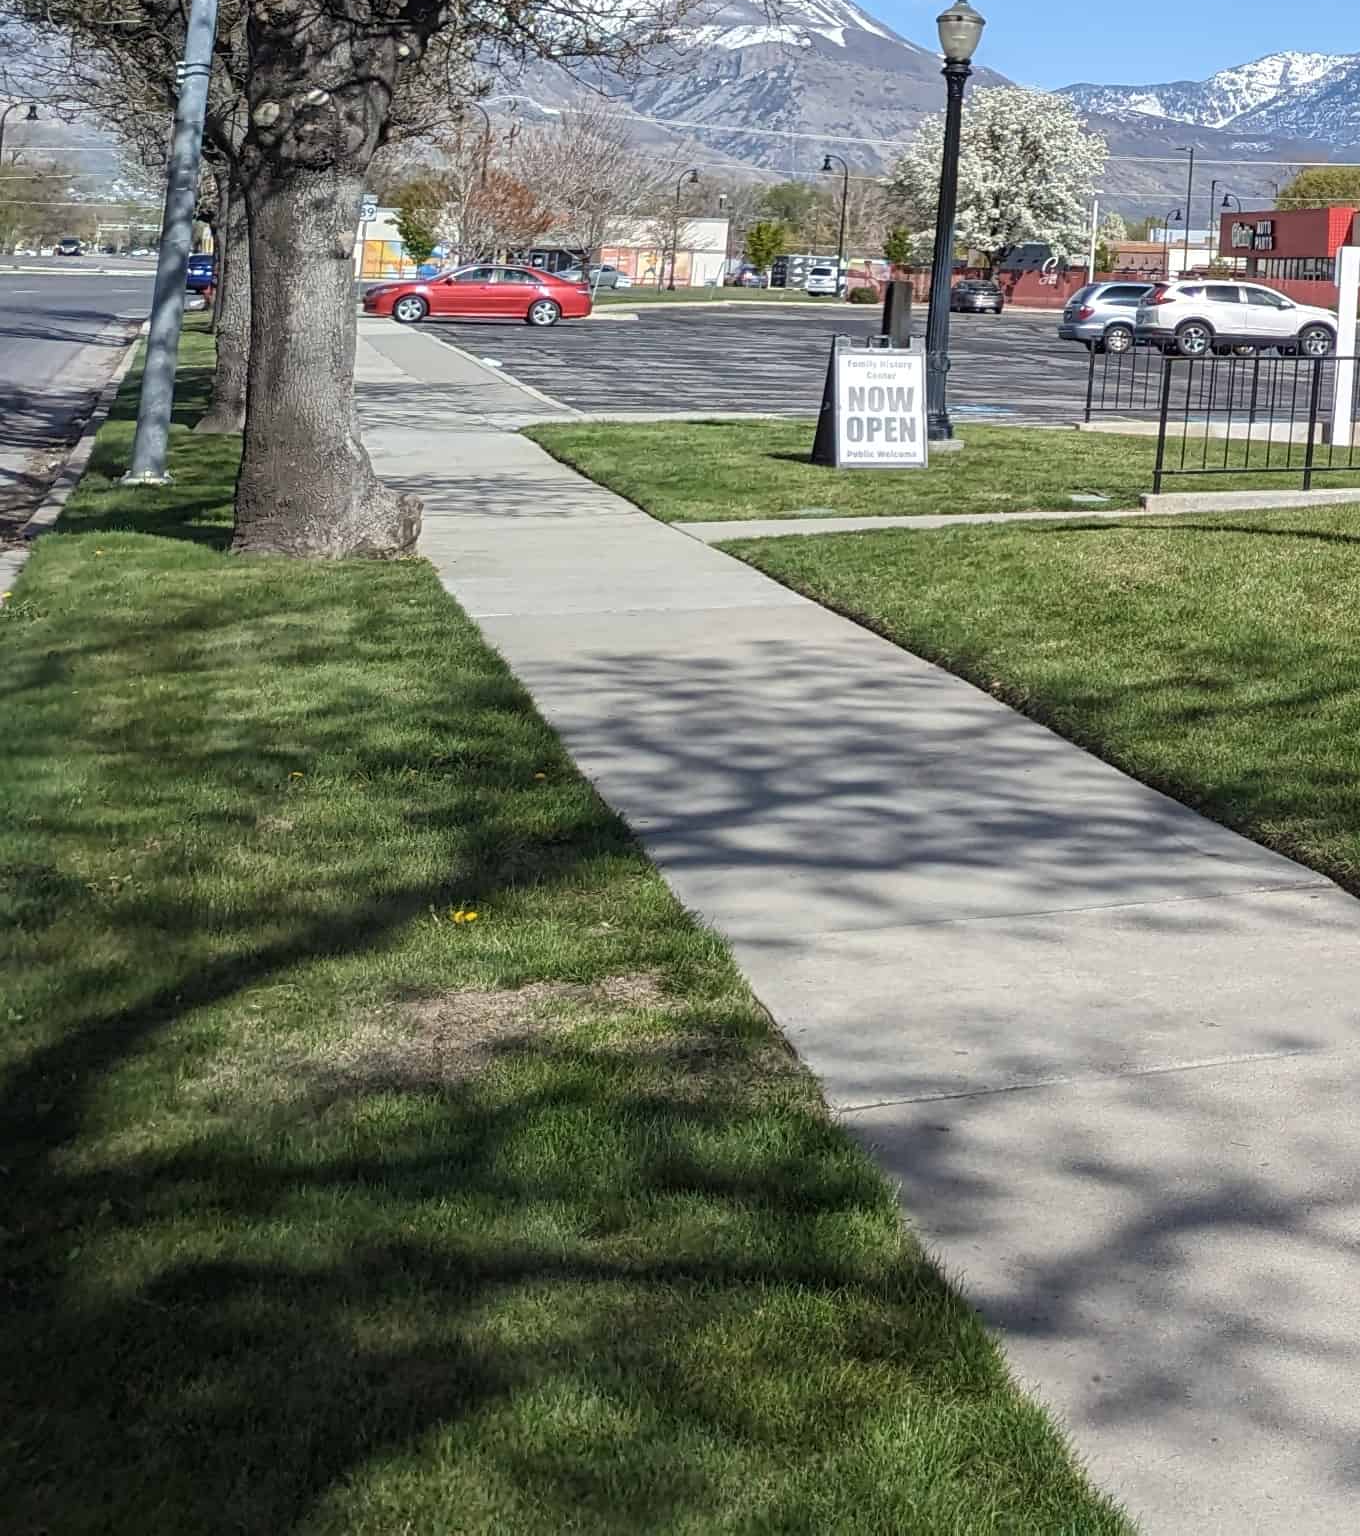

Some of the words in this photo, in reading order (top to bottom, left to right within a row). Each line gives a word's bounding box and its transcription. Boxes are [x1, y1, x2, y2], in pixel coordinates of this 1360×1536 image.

[847, 360, 877, 370] Family
[880, 360, 912, 370] History
[848, 386, 914, 412] NOW
[846, 417, 916, 442] OPEN
